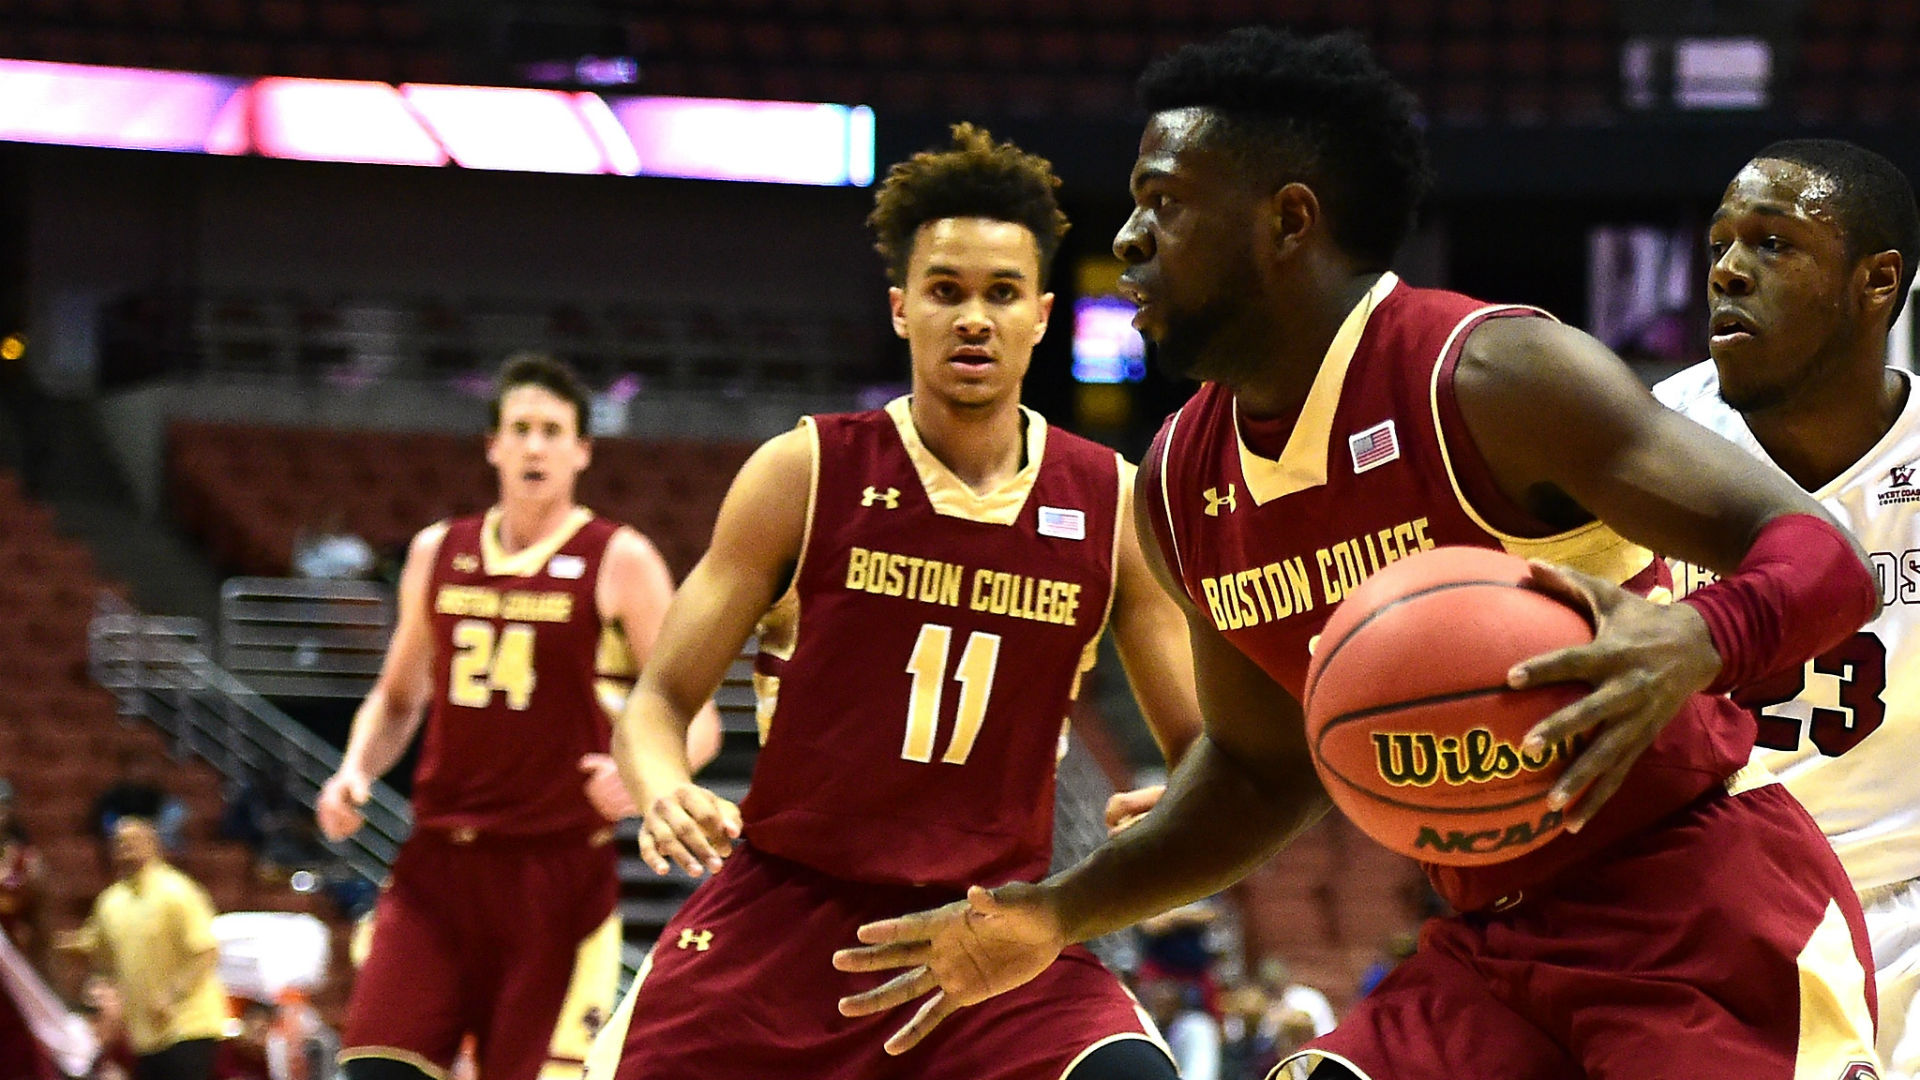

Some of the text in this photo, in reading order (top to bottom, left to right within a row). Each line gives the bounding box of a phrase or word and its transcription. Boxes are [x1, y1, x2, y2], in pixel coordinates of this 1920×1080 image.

[1877, 491, 1900, 500] WEST
[846, 547, 1081, 626] BOSTON COLLEGE
[1201, 556, 1314, 631] BOSTON
[449, 619, 537, 711] 24
[901, 623, 1002, 765] 11
[1730, 631, 1887, 758] 23
[1415, 810, 1562, 853] NCAA
